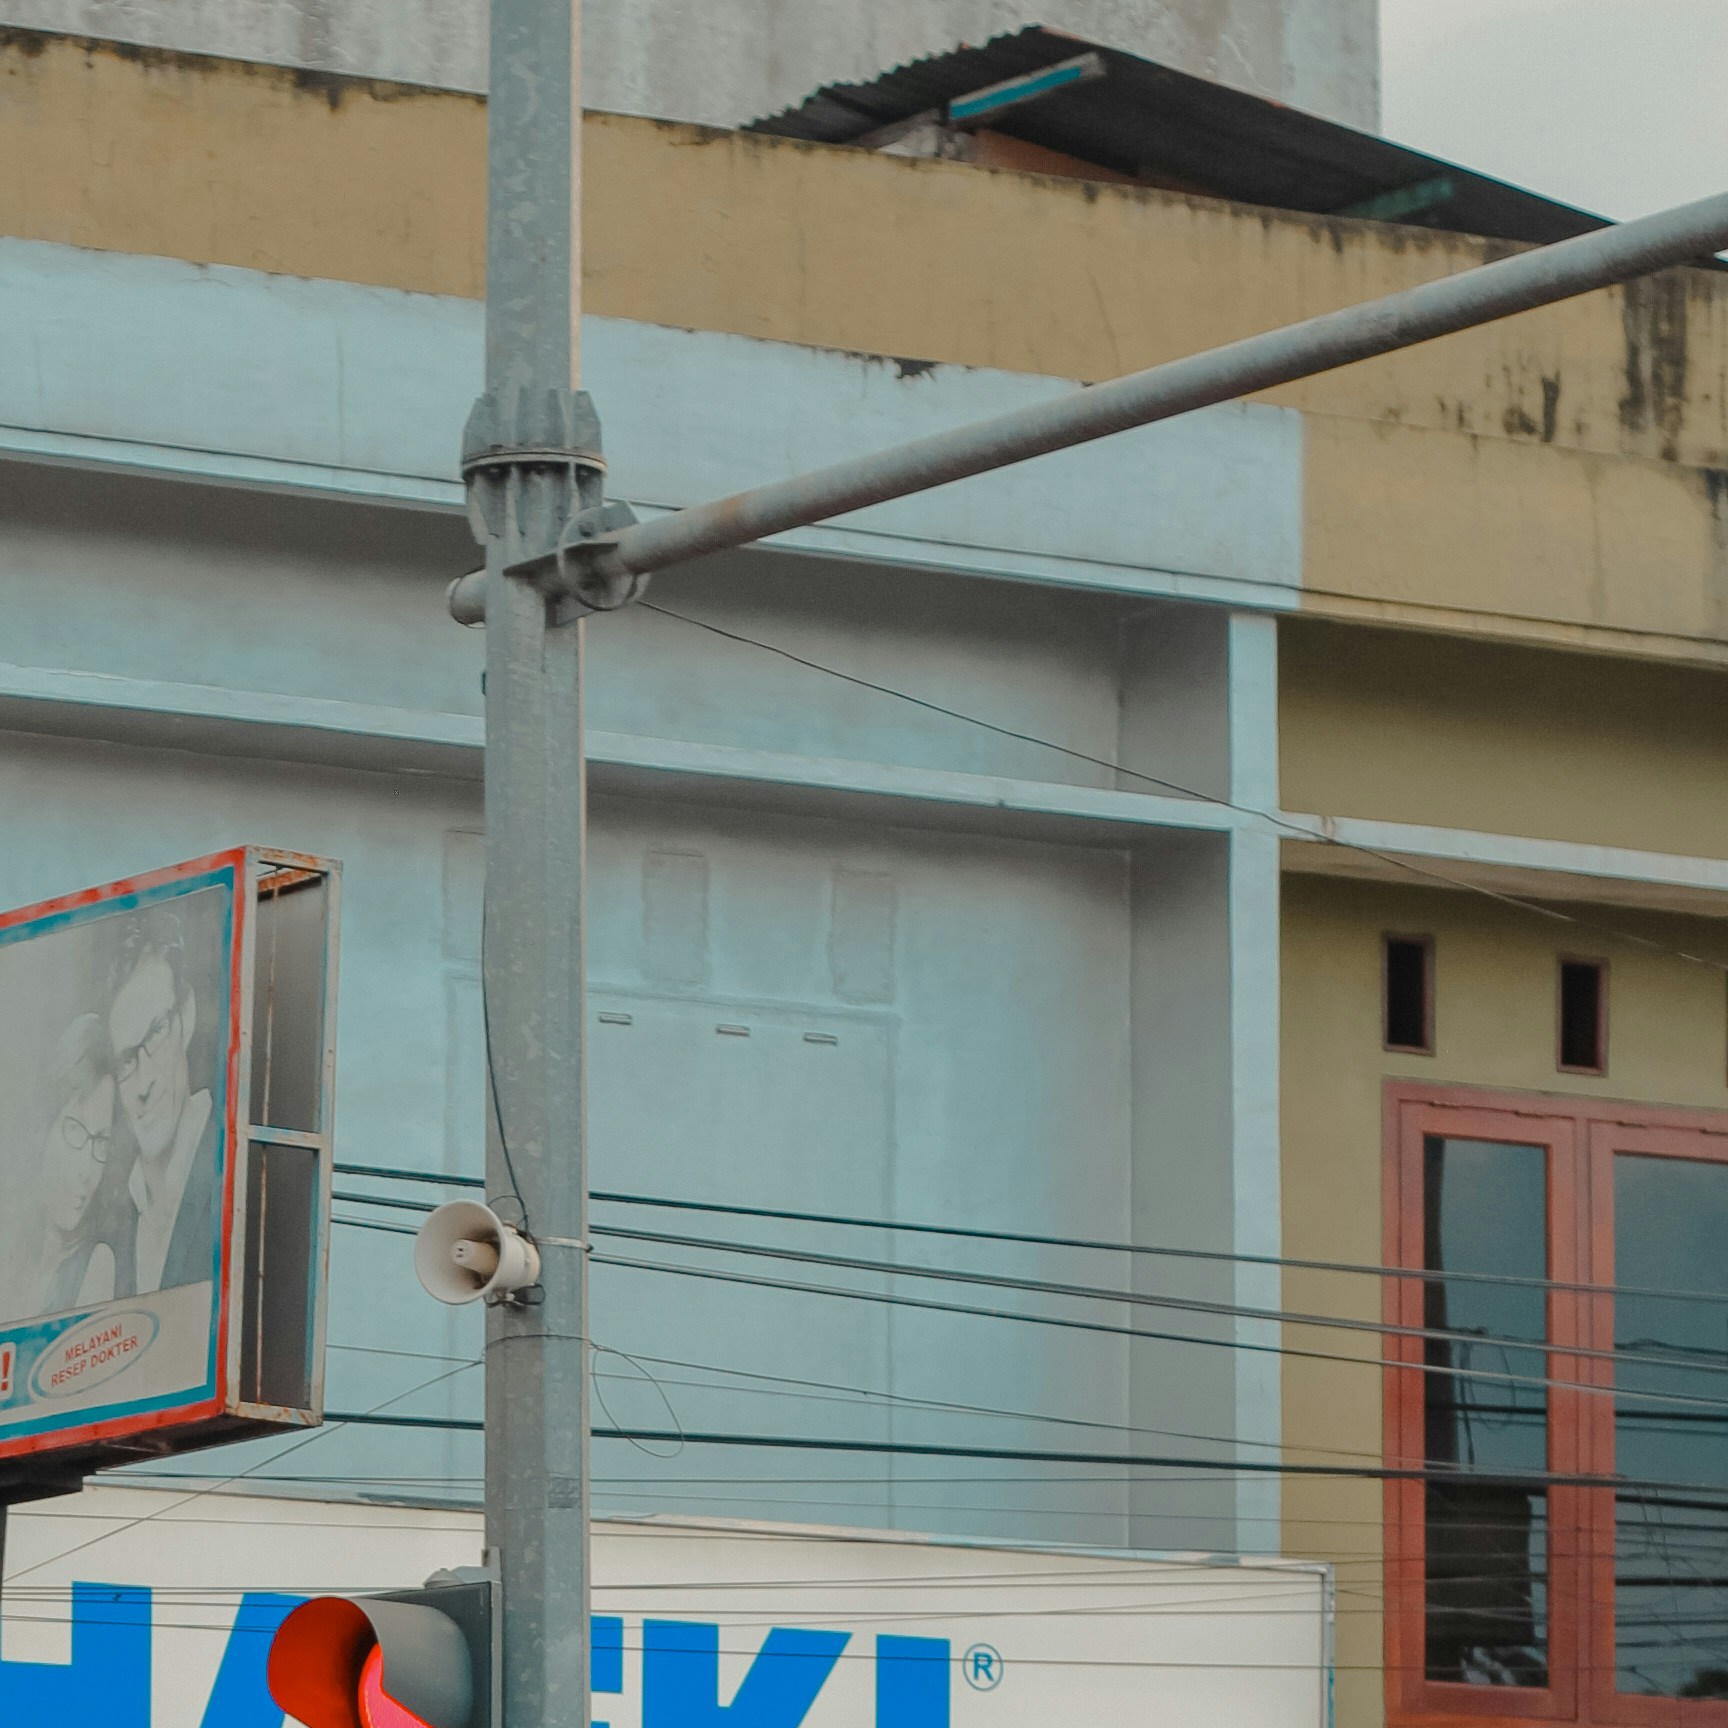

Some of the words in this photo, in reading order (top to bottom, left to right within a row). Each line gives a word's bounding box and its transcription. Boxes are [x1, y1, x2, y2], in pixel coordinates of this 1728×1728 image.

[51, 1358, 87, 1387] RESEP
[90, 1335, 139, 1369] DOKTER
[64, 1324, 123, 1361] MELAYANI
